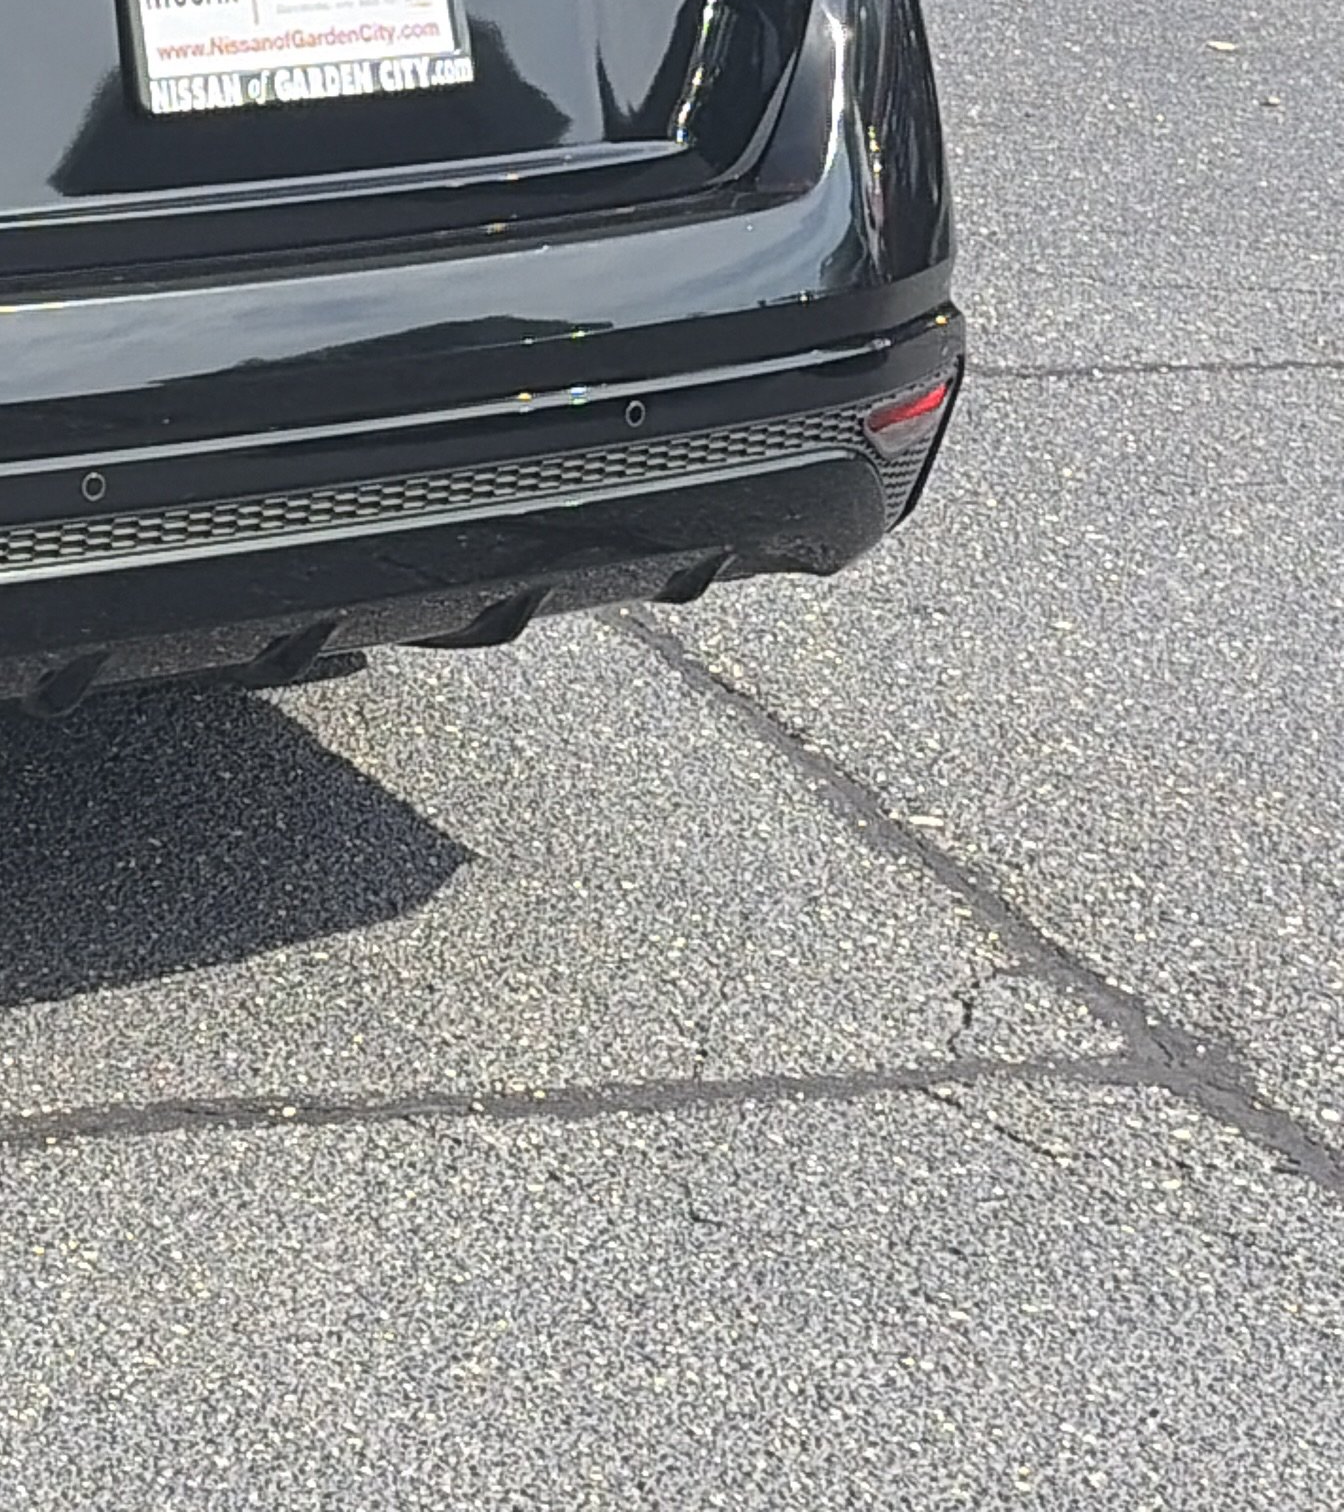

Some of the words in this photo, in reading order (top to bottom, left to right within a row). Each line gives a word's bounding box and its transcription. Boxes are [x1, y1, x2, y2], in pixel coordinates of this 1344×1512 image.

[157, 22, 441, 61] www.NissanofGardenCity.com
[149, 72, 244, 114] NISSAN
[248, 68, 271, 105] of
[274, 61, 375, 102] GARDEN
[379, 55, 475, 92] CITY.com
